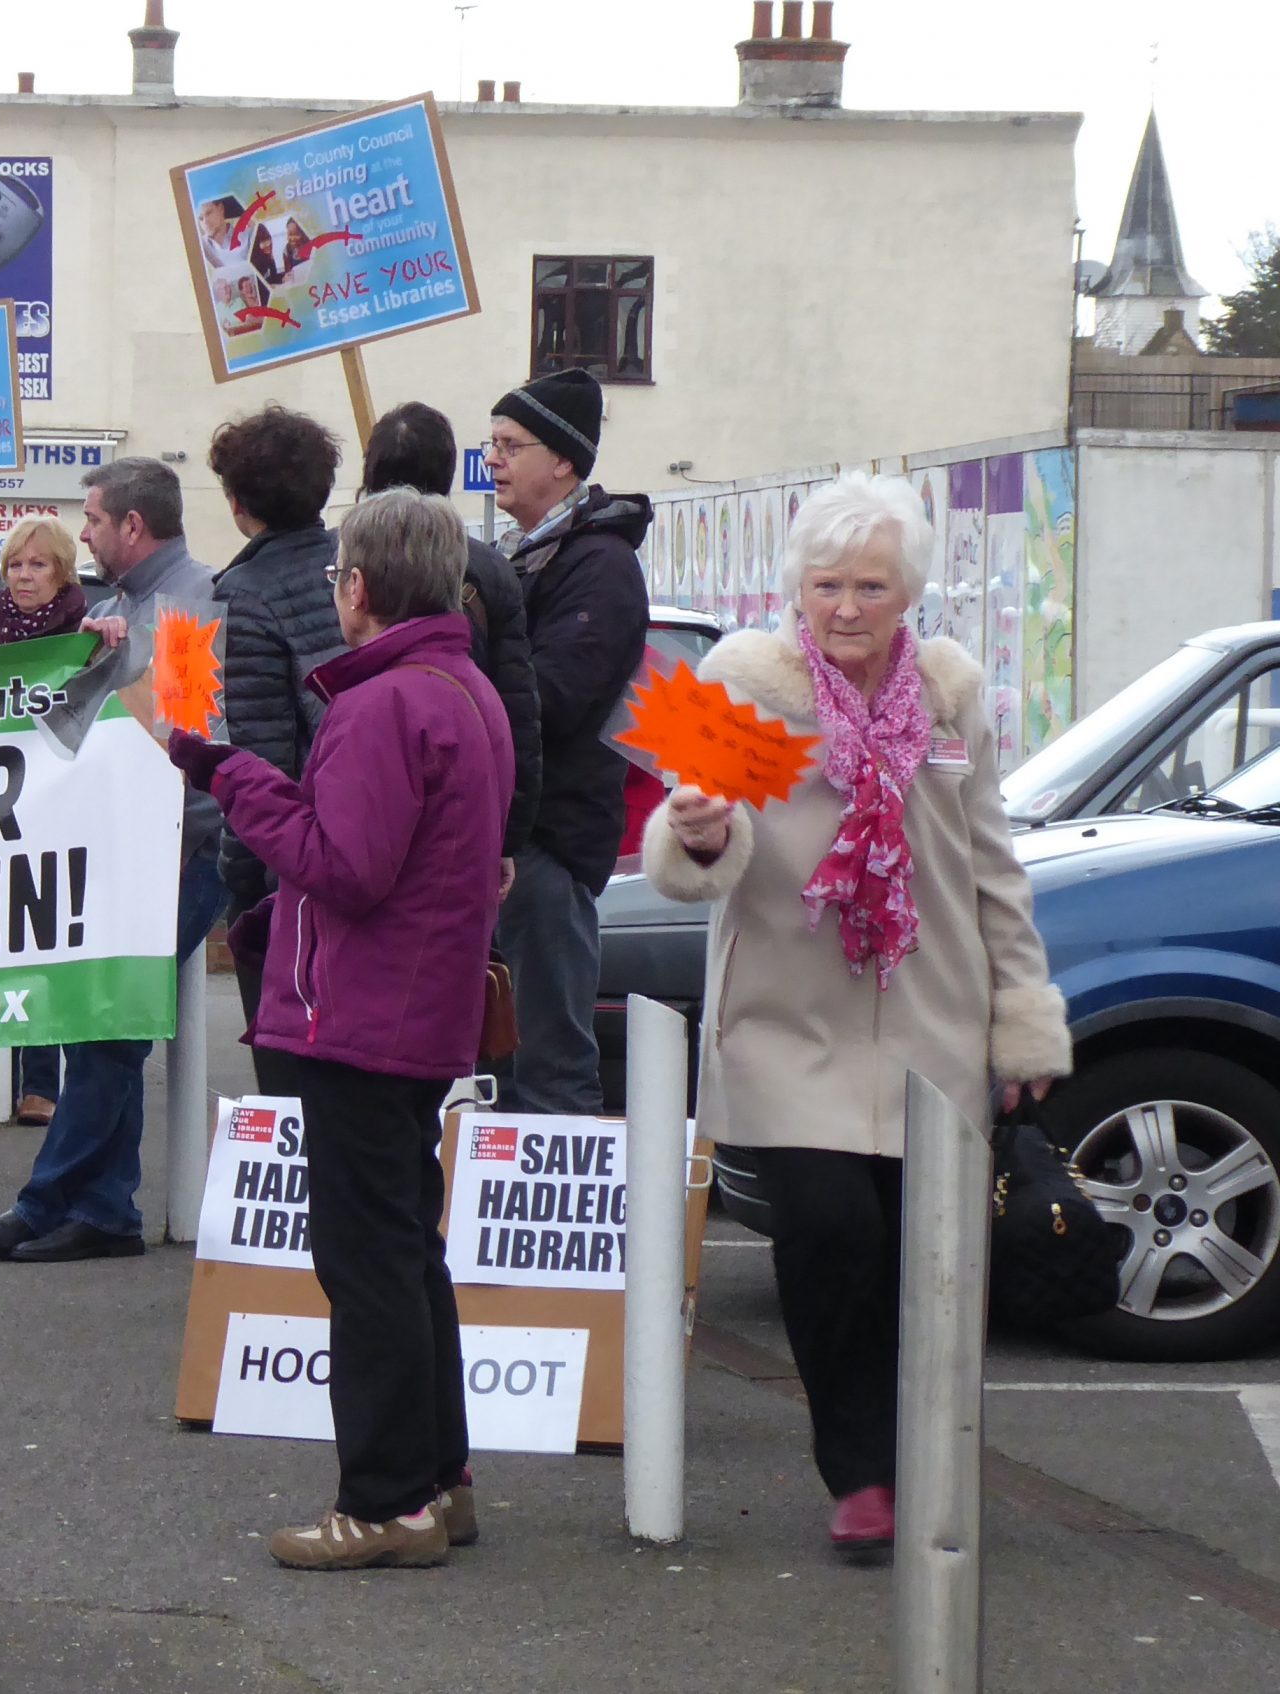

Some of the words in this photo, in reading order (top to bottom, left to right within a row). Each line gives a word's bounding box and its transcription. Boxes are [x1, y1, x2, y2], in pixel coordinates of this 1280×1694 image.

[256, 160, 299, 183] Essex
[304, 141, 354, 169] County
[358, 123, 413, 153] Council
[284, 163, 368, 200] stabbing
[327, 172, 414, 226] heart
[346, 220, 438, 258] community
[376, 214, 404, 232] your
[308, 272, 370, 308] SAVE
[380, 251, 453, 284] YOUR
[317, 302, 370, 328] Essex
[373, 278, 456, 313] Libraries
[470, 455, 491, 482] IN
[229, 1131, 255, 1139] ESSEX
[231, 1124, 272, 1133] LIBRARIES
[472, 1143, 515, 1151] LIBRARIES
[471, 1150, 496, 1158] ESSEX
[520, 1133, 616, 1177] SAVE
[477, 1180, 626, 1226] HADLEIG
[230, 1207, 310, 1252] LIBR
[240, 1346, 331, 1385] HOO
[468, 1359, 566, 1398] OOT
